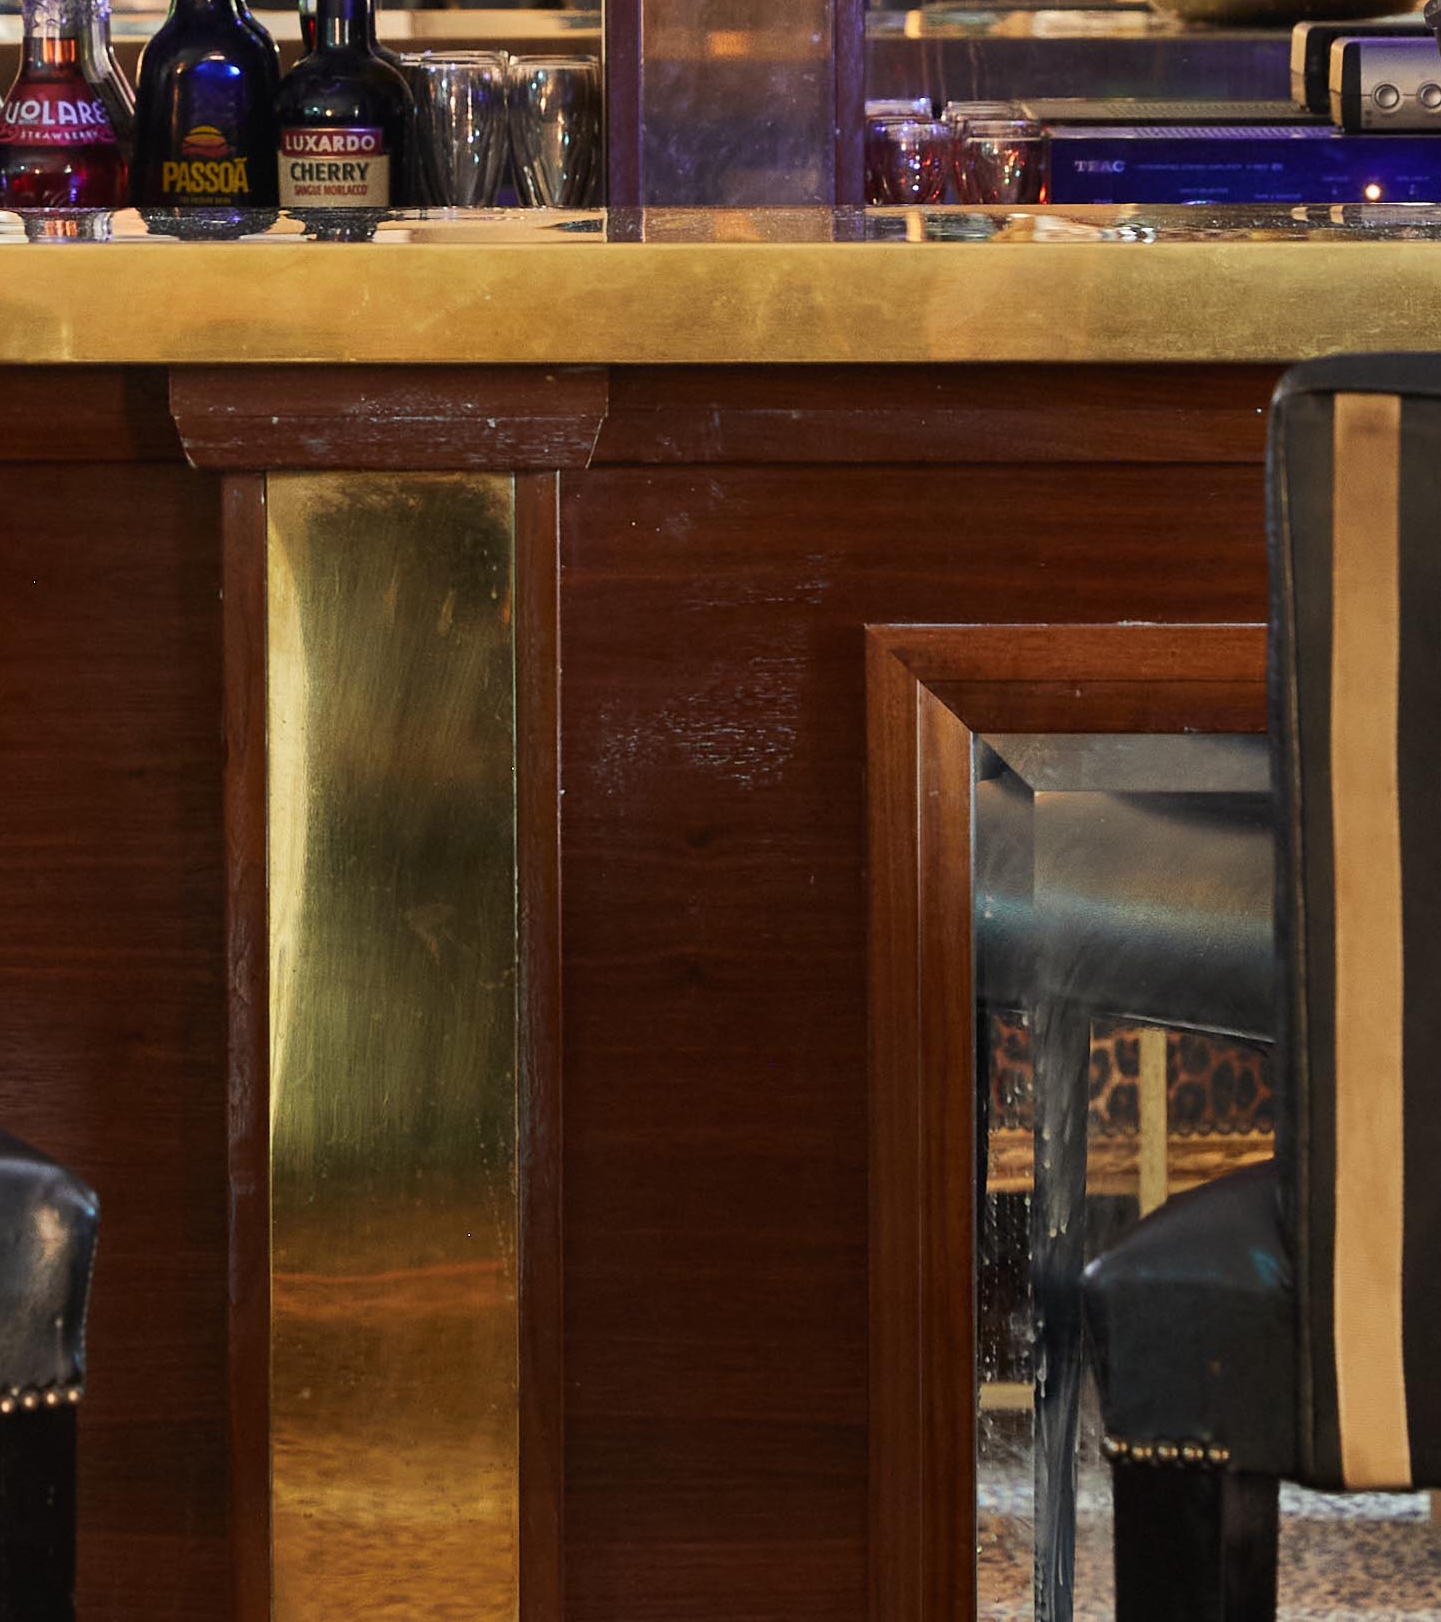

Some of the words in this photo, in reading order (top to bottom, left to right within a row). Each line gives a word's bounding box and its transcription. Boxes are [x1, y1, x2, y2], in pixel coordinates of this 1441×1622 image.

[19, 129, 101, 141] STRAWBERRY
[284, 134, 377, 152] LUXARDO
[161, 156, 249, 194] PASSOÃ
[289, 161, 370, 183] CHERRY
[1074, 159, 1126, 173] TEAC
